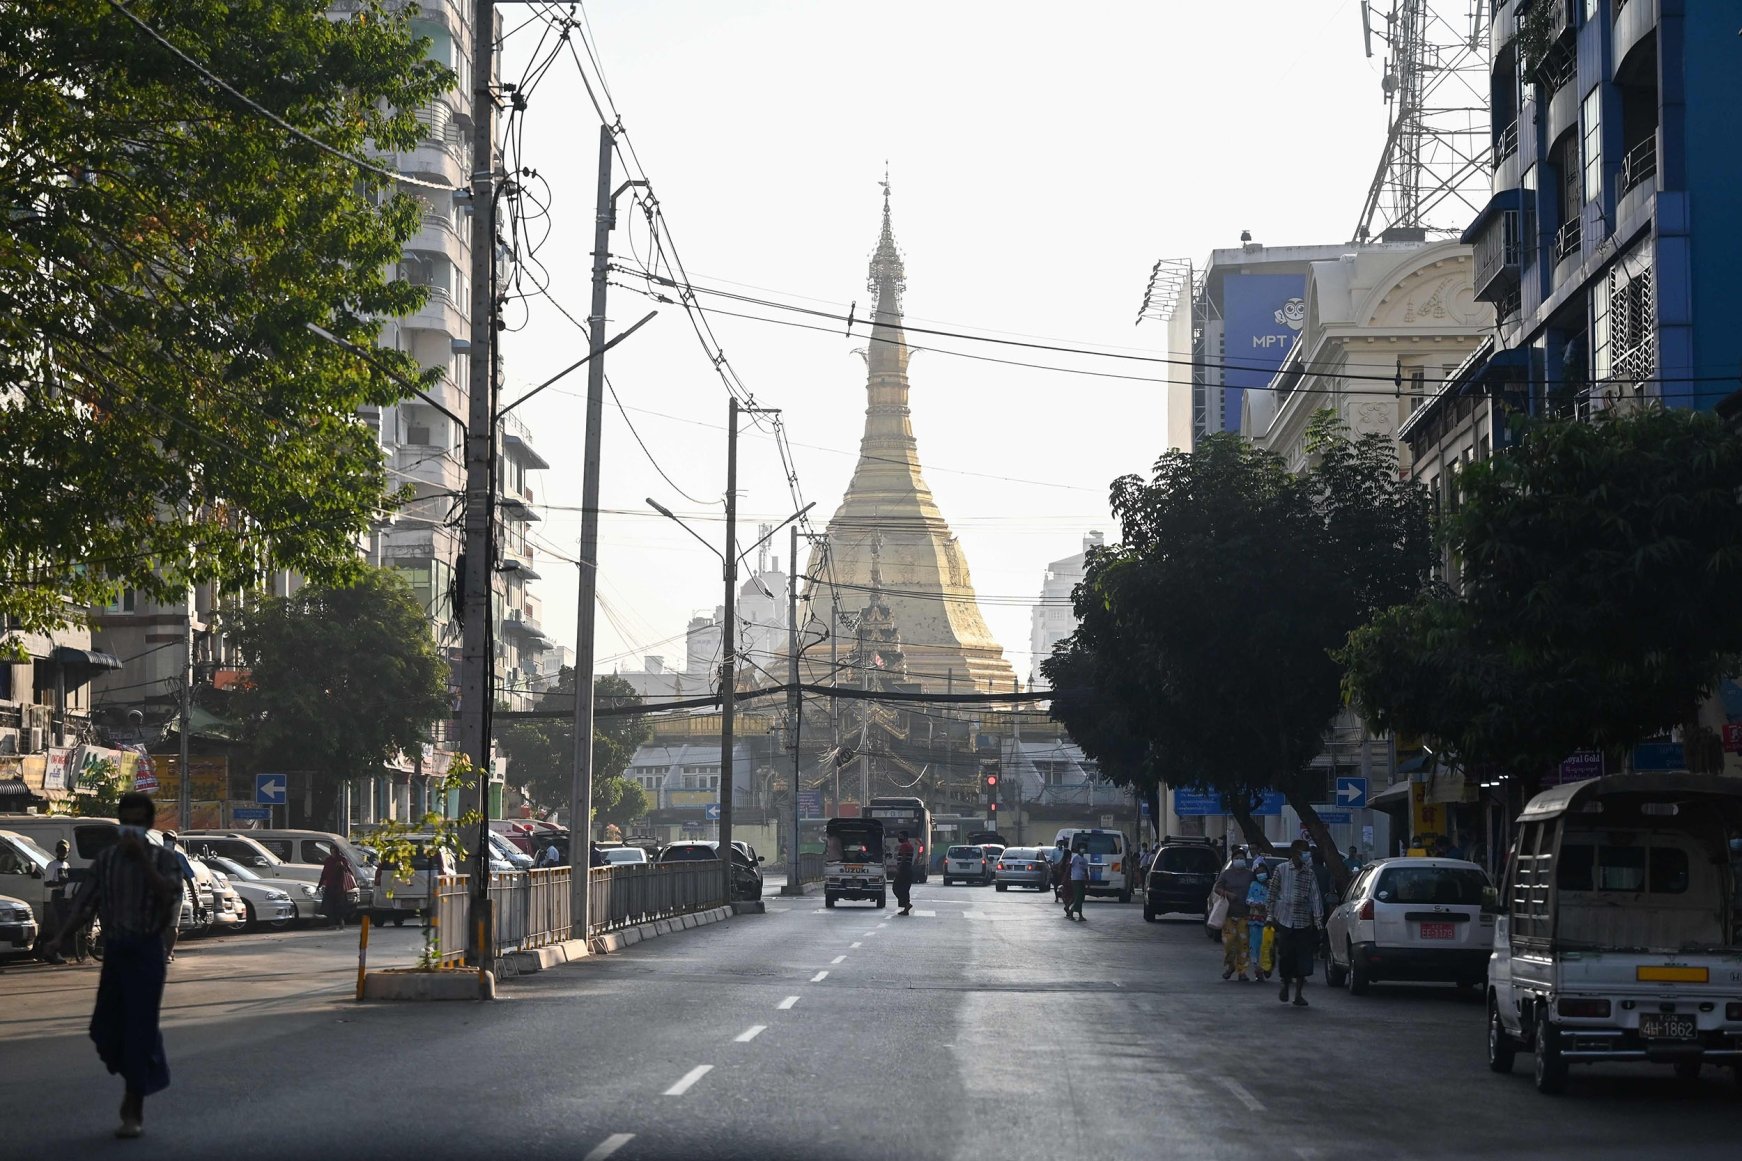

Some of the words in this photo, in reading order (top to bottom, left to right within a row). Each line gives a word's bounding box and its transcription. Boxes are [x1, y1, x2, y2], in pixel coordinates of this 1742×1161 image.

[1252, 335, 1287, 348] MPT
[1584, 754, 1600, 763] Gold
[1641, 1022, 1693, 1037] 4H-1862
